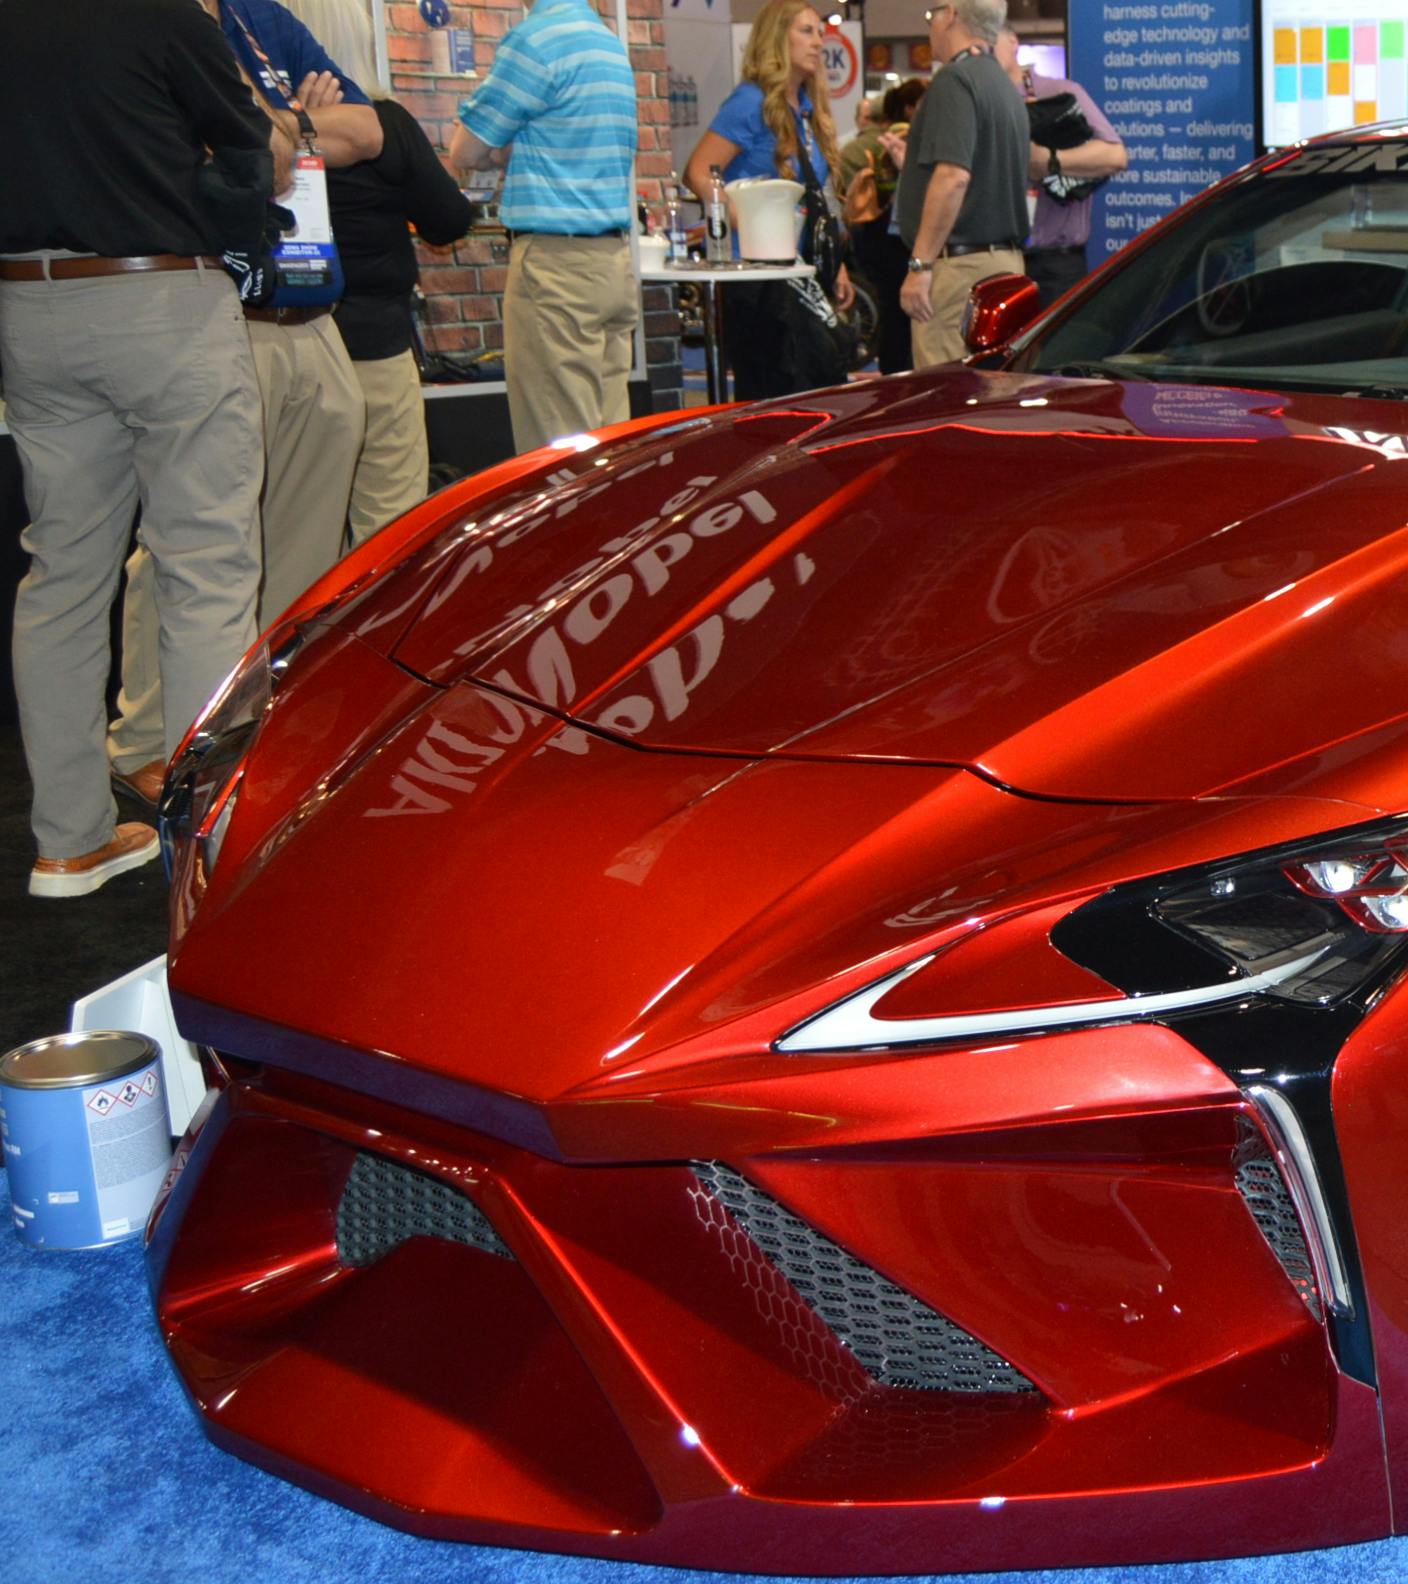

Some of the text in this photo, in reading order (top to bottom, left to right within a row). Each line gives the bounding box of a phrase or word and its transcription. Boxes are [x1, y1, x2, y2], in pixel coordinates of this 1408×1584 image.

[1103, 2, 1215, 20] harness cutting-
[1103, 24, 1250, 46] edge technology and
[1103, 48, 1240, 68] data-driven insights
[1104, 74, 1208, 90] to revolutionize
[1103, 98, 1162, 116] coatings
[1165, 97, 1193, 113] and
[1113, 120, 1165, 137] olutions
[1186, 120, 1254, 140] delivering
[1127, 144, 1236, 162] arter, faster, and
[1143, 167, 1222, 184] sustainable
[1105, 190, 1177, 207] outcomes.
[1105, 214, 1136, 230] isn't
